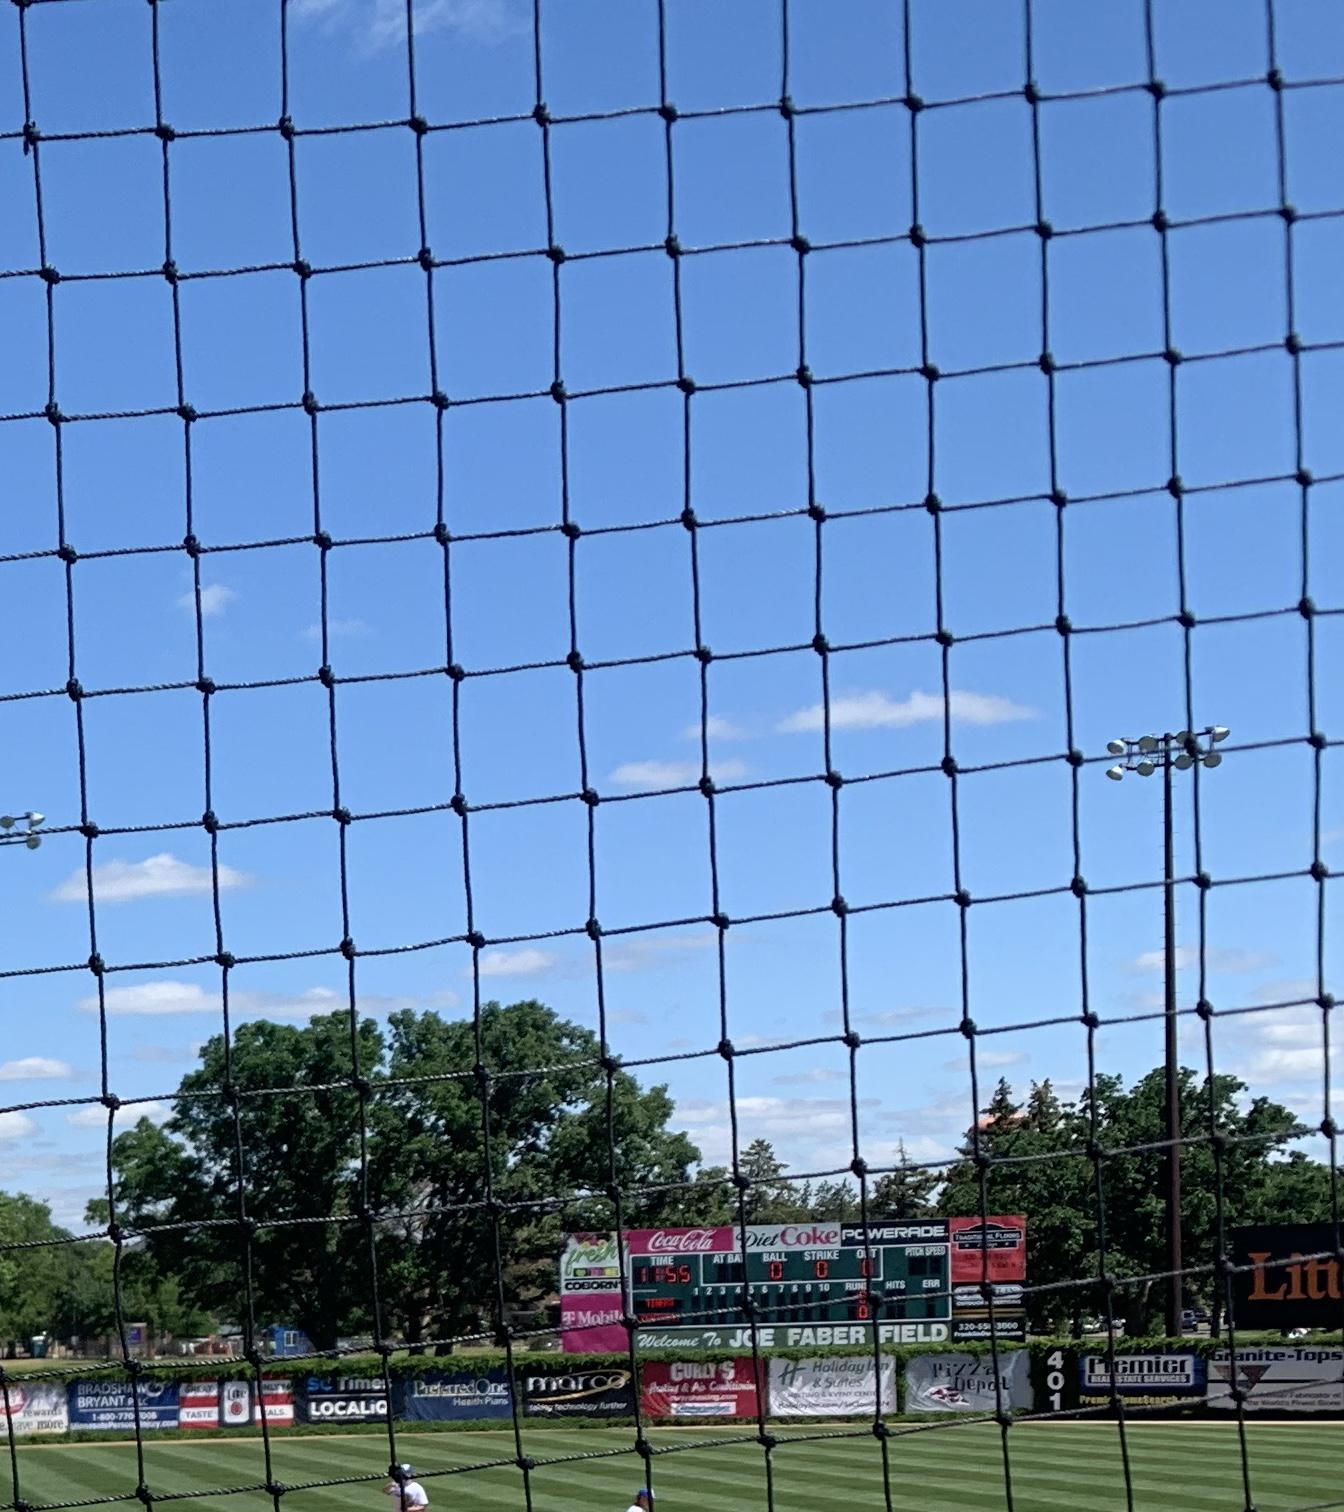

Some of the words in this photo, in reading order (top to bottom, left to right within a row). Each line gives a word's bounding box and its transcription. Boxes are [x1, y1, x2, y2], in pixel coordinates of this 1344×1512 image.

[781, 1226, 838, 1246] Coke
[804, 1250, 839, 1261] STRIKE
[856, 1248, 877, 1258] OT
[905, 1247, 924, 1256] PITCH
[925, 1246, 945, 1256] SPEED
[650, 1257, 674, 1266] TIME
[713, 1254, 724, 1263] AT
[763, 1253, 787, 1262] BALL
[706, 1287, 712, 1295] 2
[720, 1287, 726, 1295] 3
[735, 1286, 742, 1294] 4
[778, 1285, 784, 1293] 7
[818, 1283, 830, 1292] 10
[885, 1281, 906, 1290] HITS
[922, 1279, 940, 1289] ERR
[578, 1309, 625, 1324] Mobile
[638, 1333, 699, 1348] Welcome
[703, 1331, 721, 1346] To
[729, 1328, 775, 1347] JOE
[787, 1326, 866, 1346] FABER
[879, 1323, 948, 1344] FIELD
[1213, 1349, 1344, 1364] Granite-Tops
[812, 1360, 865, 1375] Holiday
[867, 1361, 890, 1372] In
[1088, 1356, 1188, 1374] Premier
[527, 1375, 626, 1392] marco
[813, 1378, 821, 1388] &
[824, 1377, 863, 1389] Suites
[1047, 1351, 1065, 1410] 401
[1143, 1374, 1188, 1383] SERVICES
[414, 1378, 509, 1396] PreferredOne
[78, 1395, 126, 1408] BRYANT
[453, 1397, 484, 1407] Health
[485, 1396, 508, 1405] Plans
[555, 1402, 598, 1412] technology
[599, 1401, 628, 1410] further
[186, 1410, 213, 1419] TASTE
